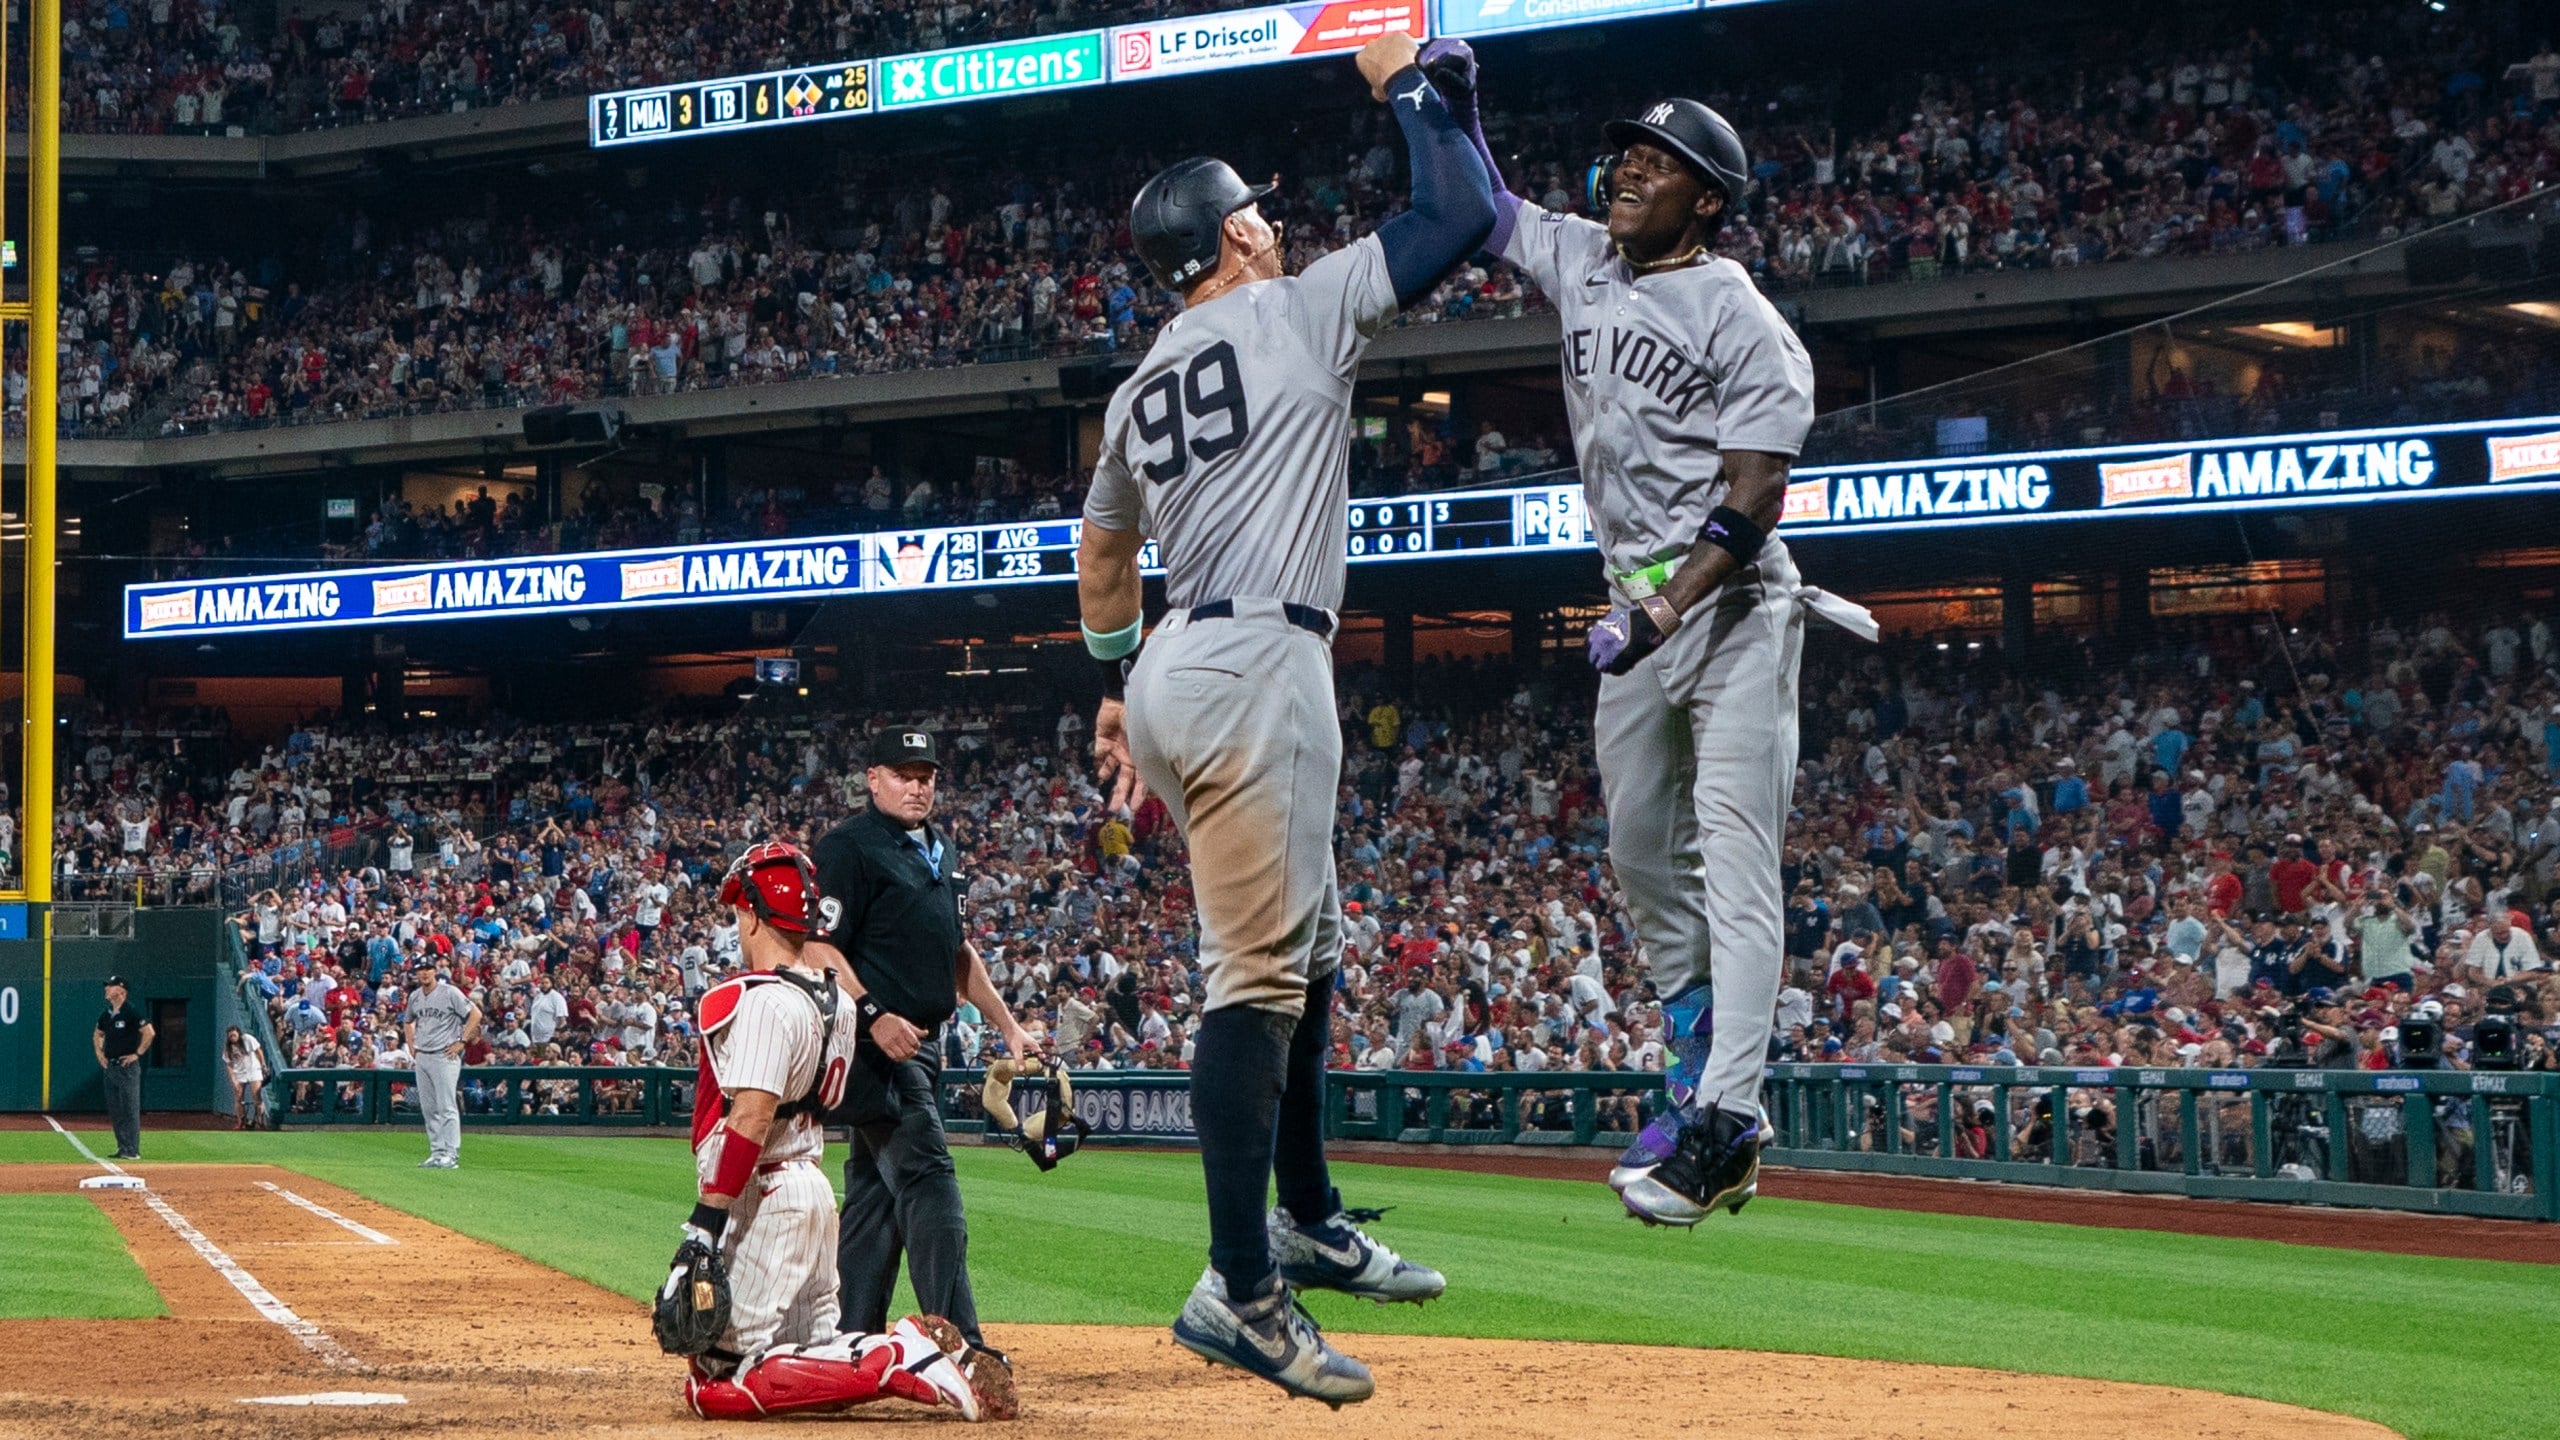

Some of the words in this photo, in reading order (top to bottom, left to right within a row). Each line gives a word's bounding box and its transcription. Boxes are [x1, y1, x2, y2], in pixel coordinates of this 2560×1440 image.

[1160, 32, 1187, 54] LF
[1195, 19, 1277, 50] Driscoll
[845, 66, 867, 86] 25
[931, 50, 1084, 97] Citizens
[630, 99, 666, 130] MIA
[679, 95, 692, 125] 3
[712, 90, 736, 121] TB
[755, 85, 769, 116] 6
[845, 88, 868, 108] 60
[1610, 326, 1714, 420] YORK
[1131, 339, 1249, 486] 99
[2196, 439, 2434, 498] AMAZING
[2501, 443, 2560, 470] MIKE
[1558, 494, 1569, 514] 5
[1832, 464, 2050, 521] AMAZING
[1350, 507, 1365, 528] 0
[1378, 506, 1393, 526] 0
[1407, 504, 1419, 524] 1
[1435, 502, 1449, 522] 3
[1525, 500, 1549, 536] R
[1557, 522, 1570, 543] 4
[950, 533, 976, 555] 2B
[997, 526, 1039, 550] AVG
[1350, 535, 1365, 555] 0
[1379, 533, 1393, 553] 0
[1407, 532, 1422, 552] 0
[686, 546, 849, 593] AMAZING
[950, 558, 976, 580] 25
[996, 551, 1041, 577] .235
[198, 581, 341, 624] AMAZING
[434, 564, 586, 608] AMAZING
[1129, 1090, 1196, 1132] BAKE
